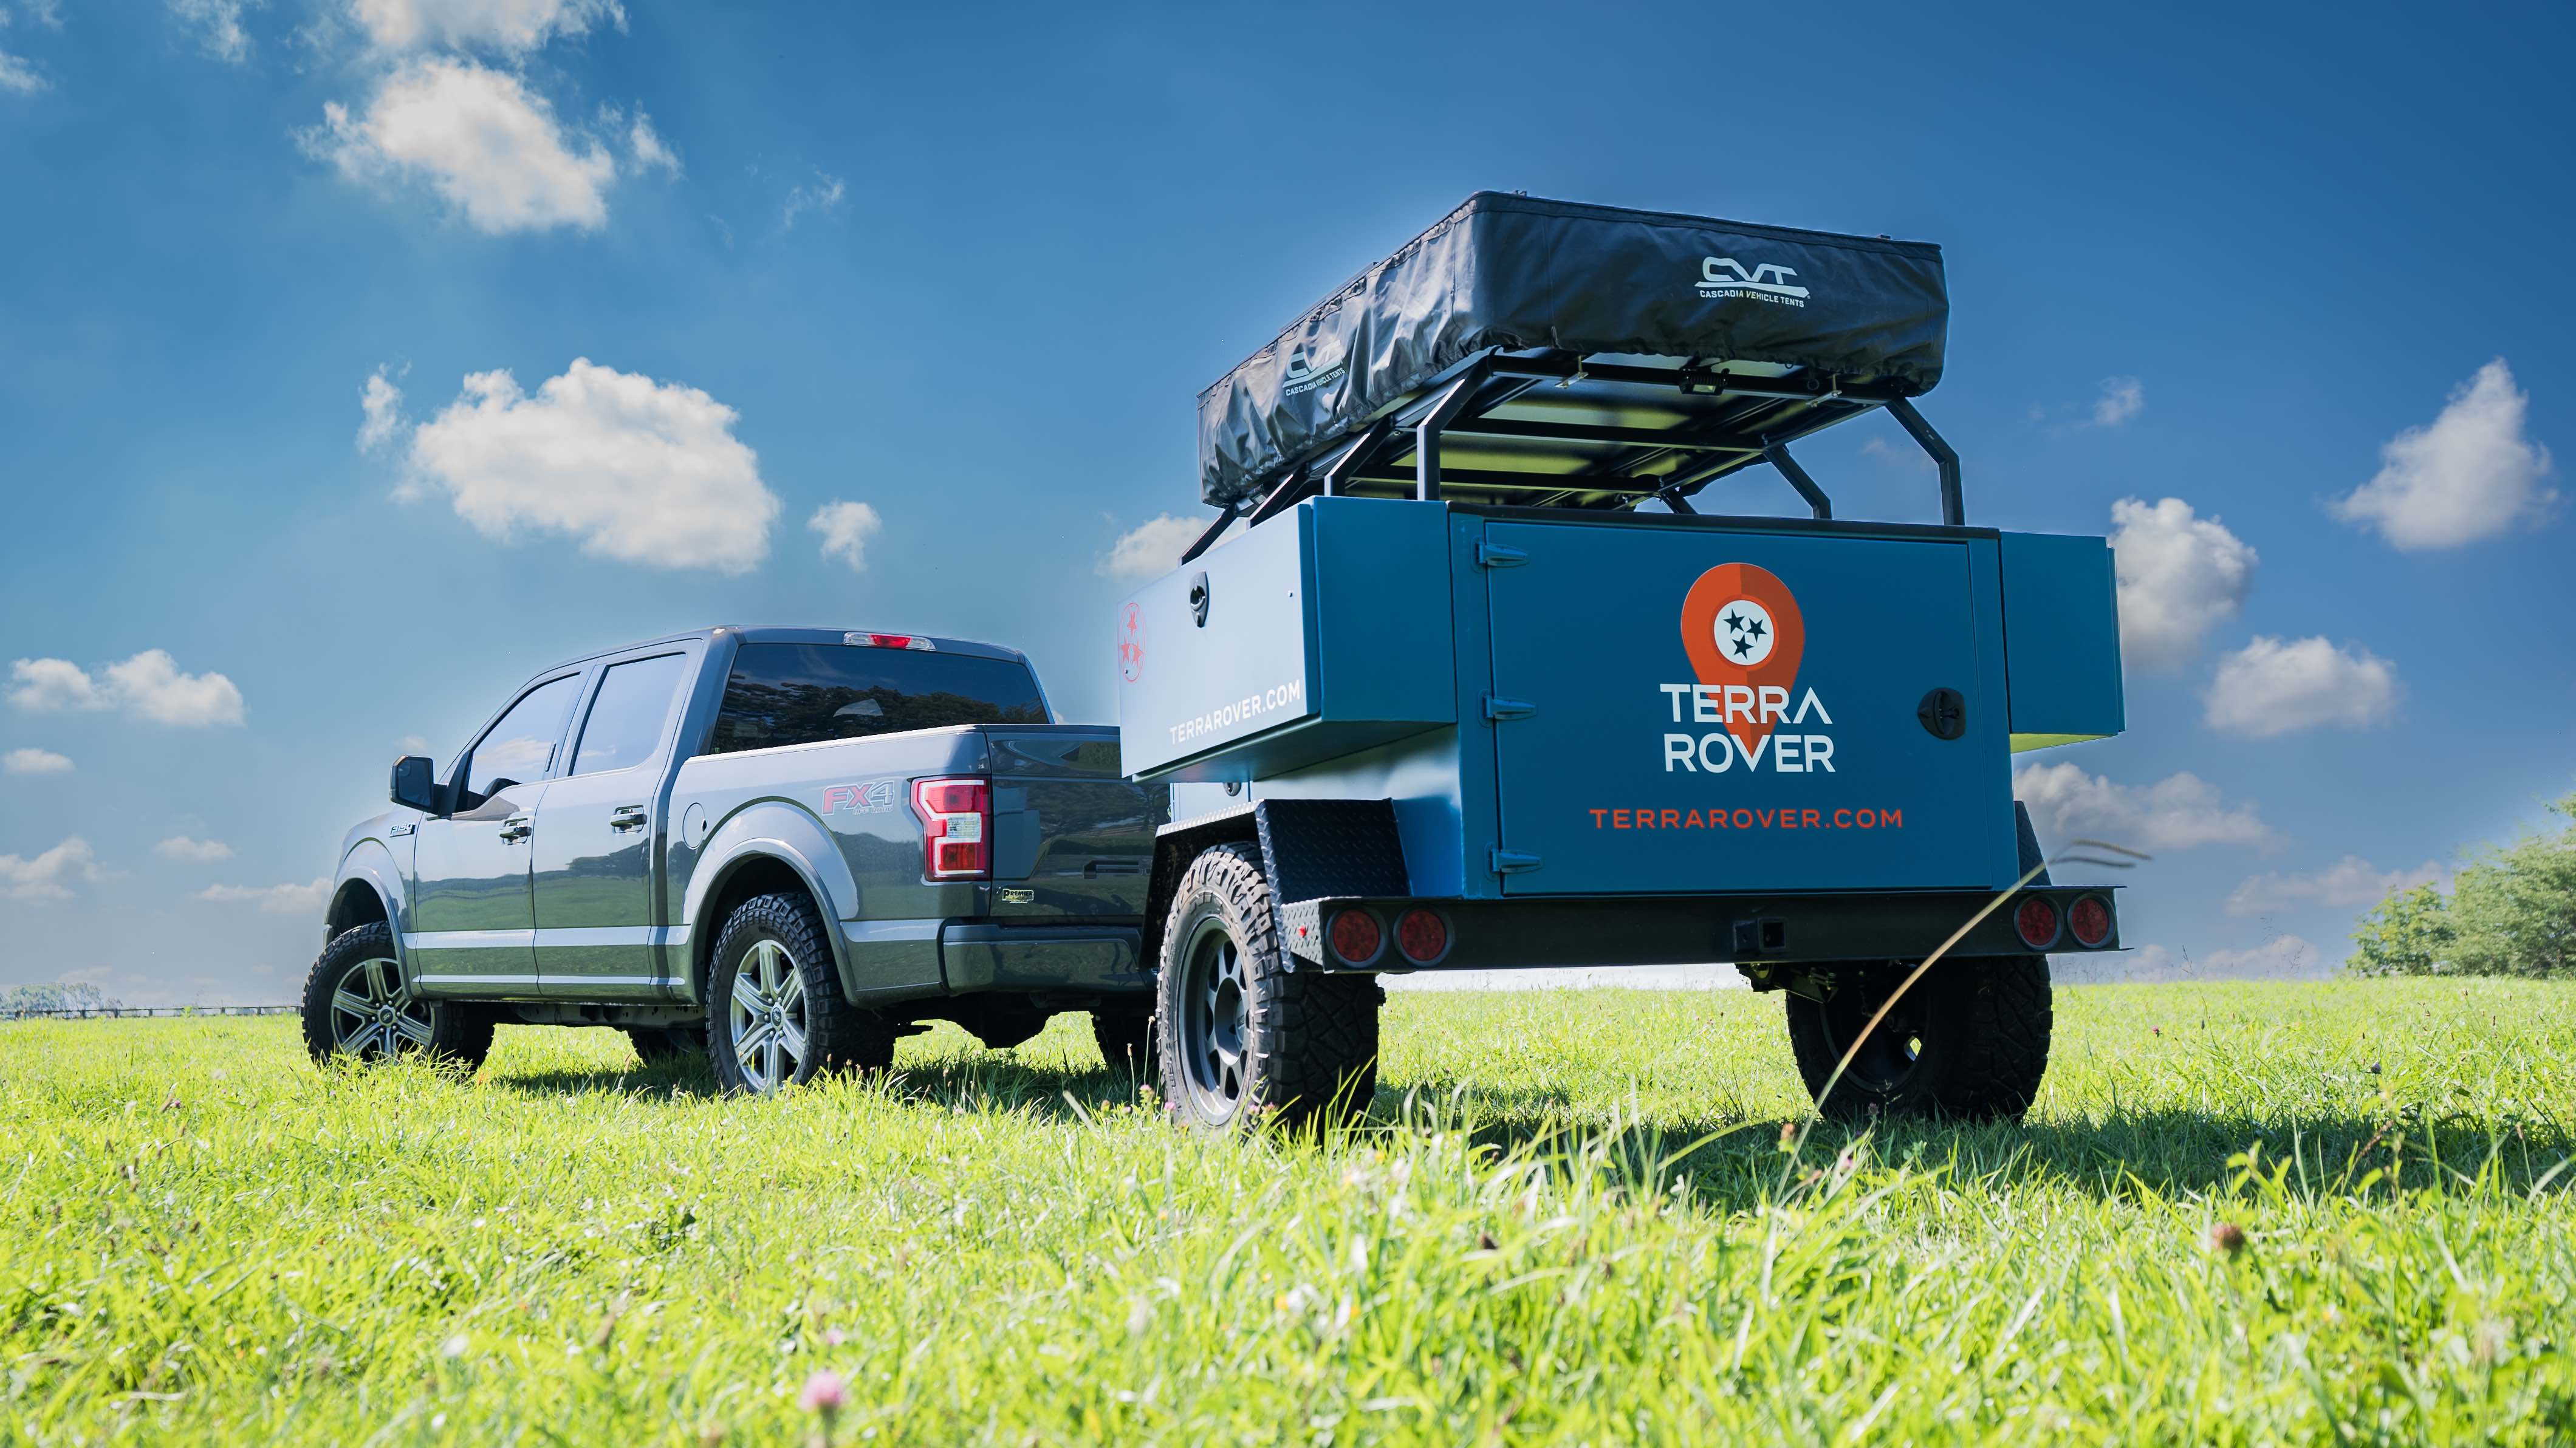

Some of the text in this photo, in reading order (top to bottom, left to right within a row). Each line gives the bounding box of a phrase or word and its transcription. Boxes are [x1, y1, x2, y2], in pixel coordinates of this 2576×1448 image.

[1702, 256, 1798, 285] CVT
[1699, 290, 1804, 308] CASCADIA VEHICLE TENTS
[1286, 381, 1317, 396] CASCADIA
[1330, 367, 1346, 379] TENTS
[1169, 679, 1301, 745] TERRAROVER.COM
[1660, 683, 1833, 724] TERRA
[1663, 733, 1836, 773] ROVER
[822, 780, 894, 816] FX4
[1589, 809, 1903, 829] TERRAROVER.COM
